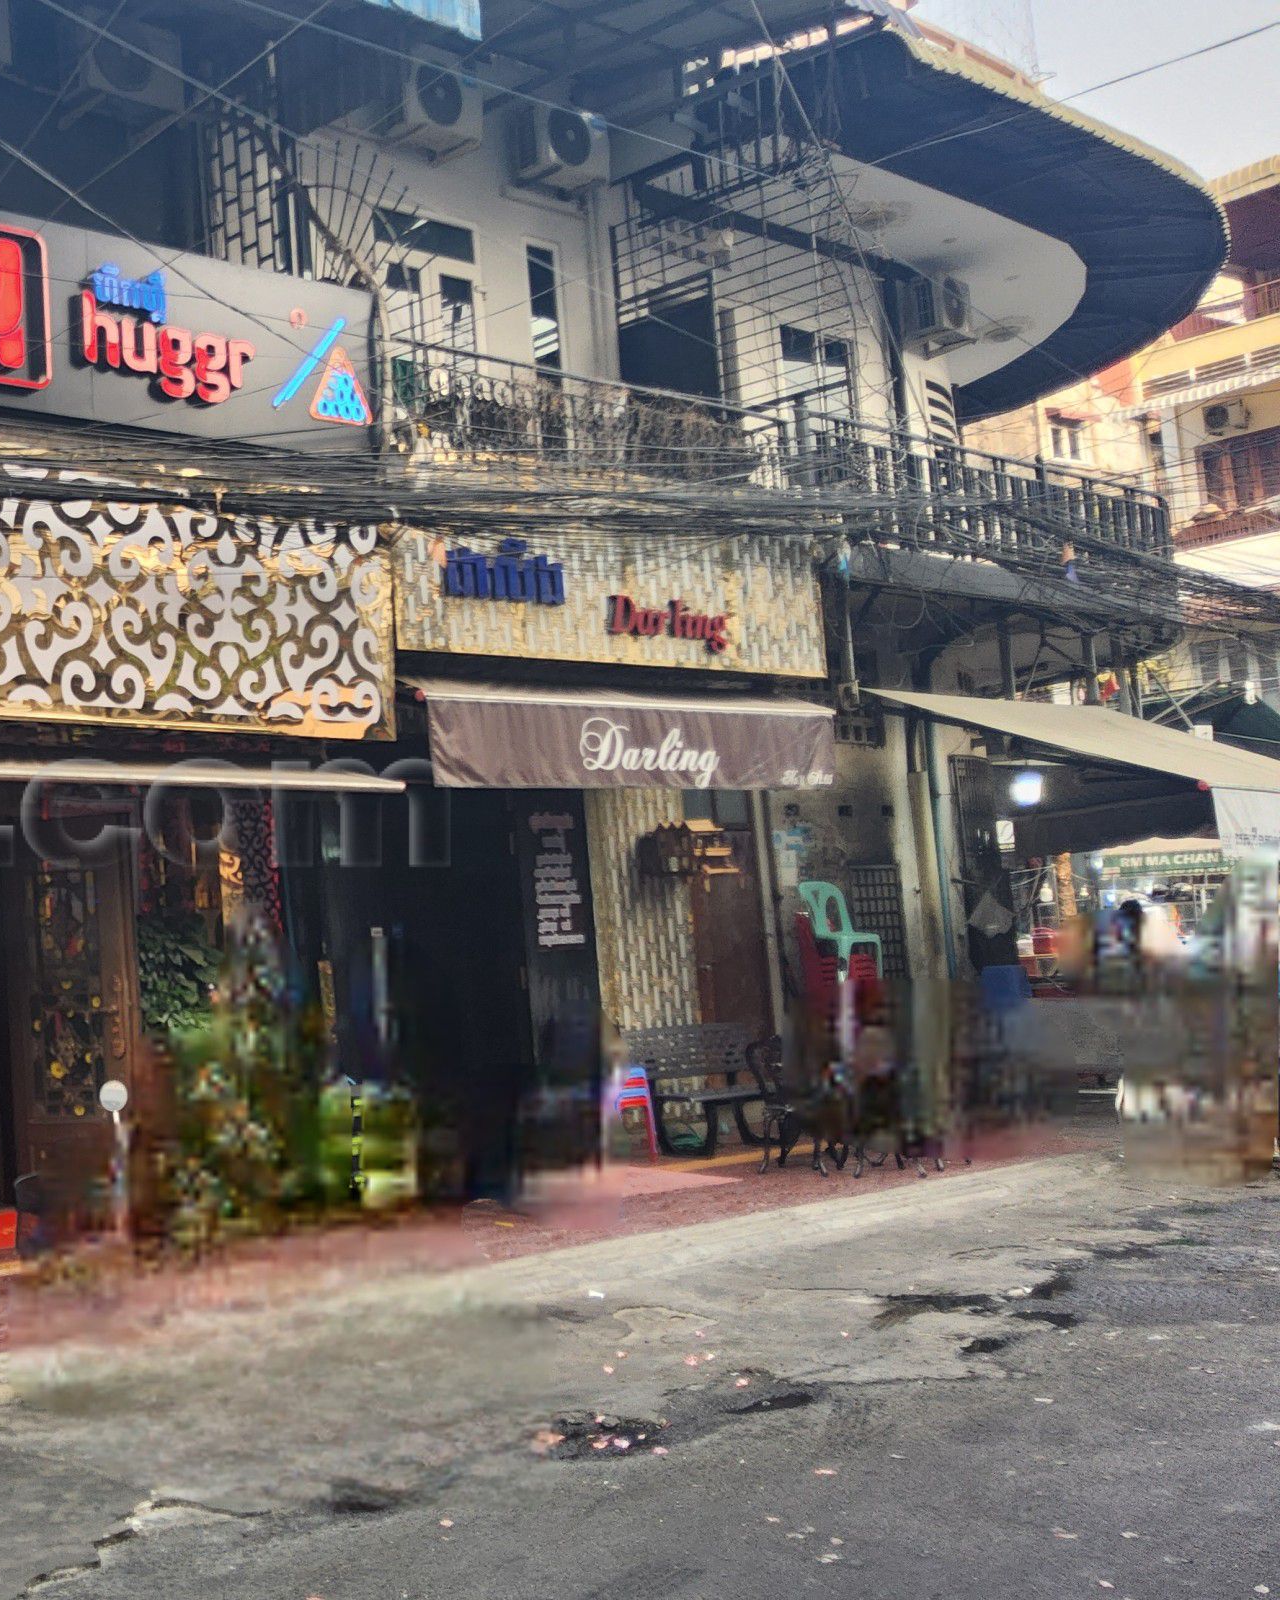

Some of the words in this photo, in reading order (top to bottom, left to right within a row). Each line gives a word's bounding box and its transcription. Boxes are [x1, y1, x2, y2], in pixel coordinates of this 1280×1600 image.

[81, 289, 256, 404] huggr
[607, 595, 728, 654] Darling
[580, 717, 720, 789] Darling
